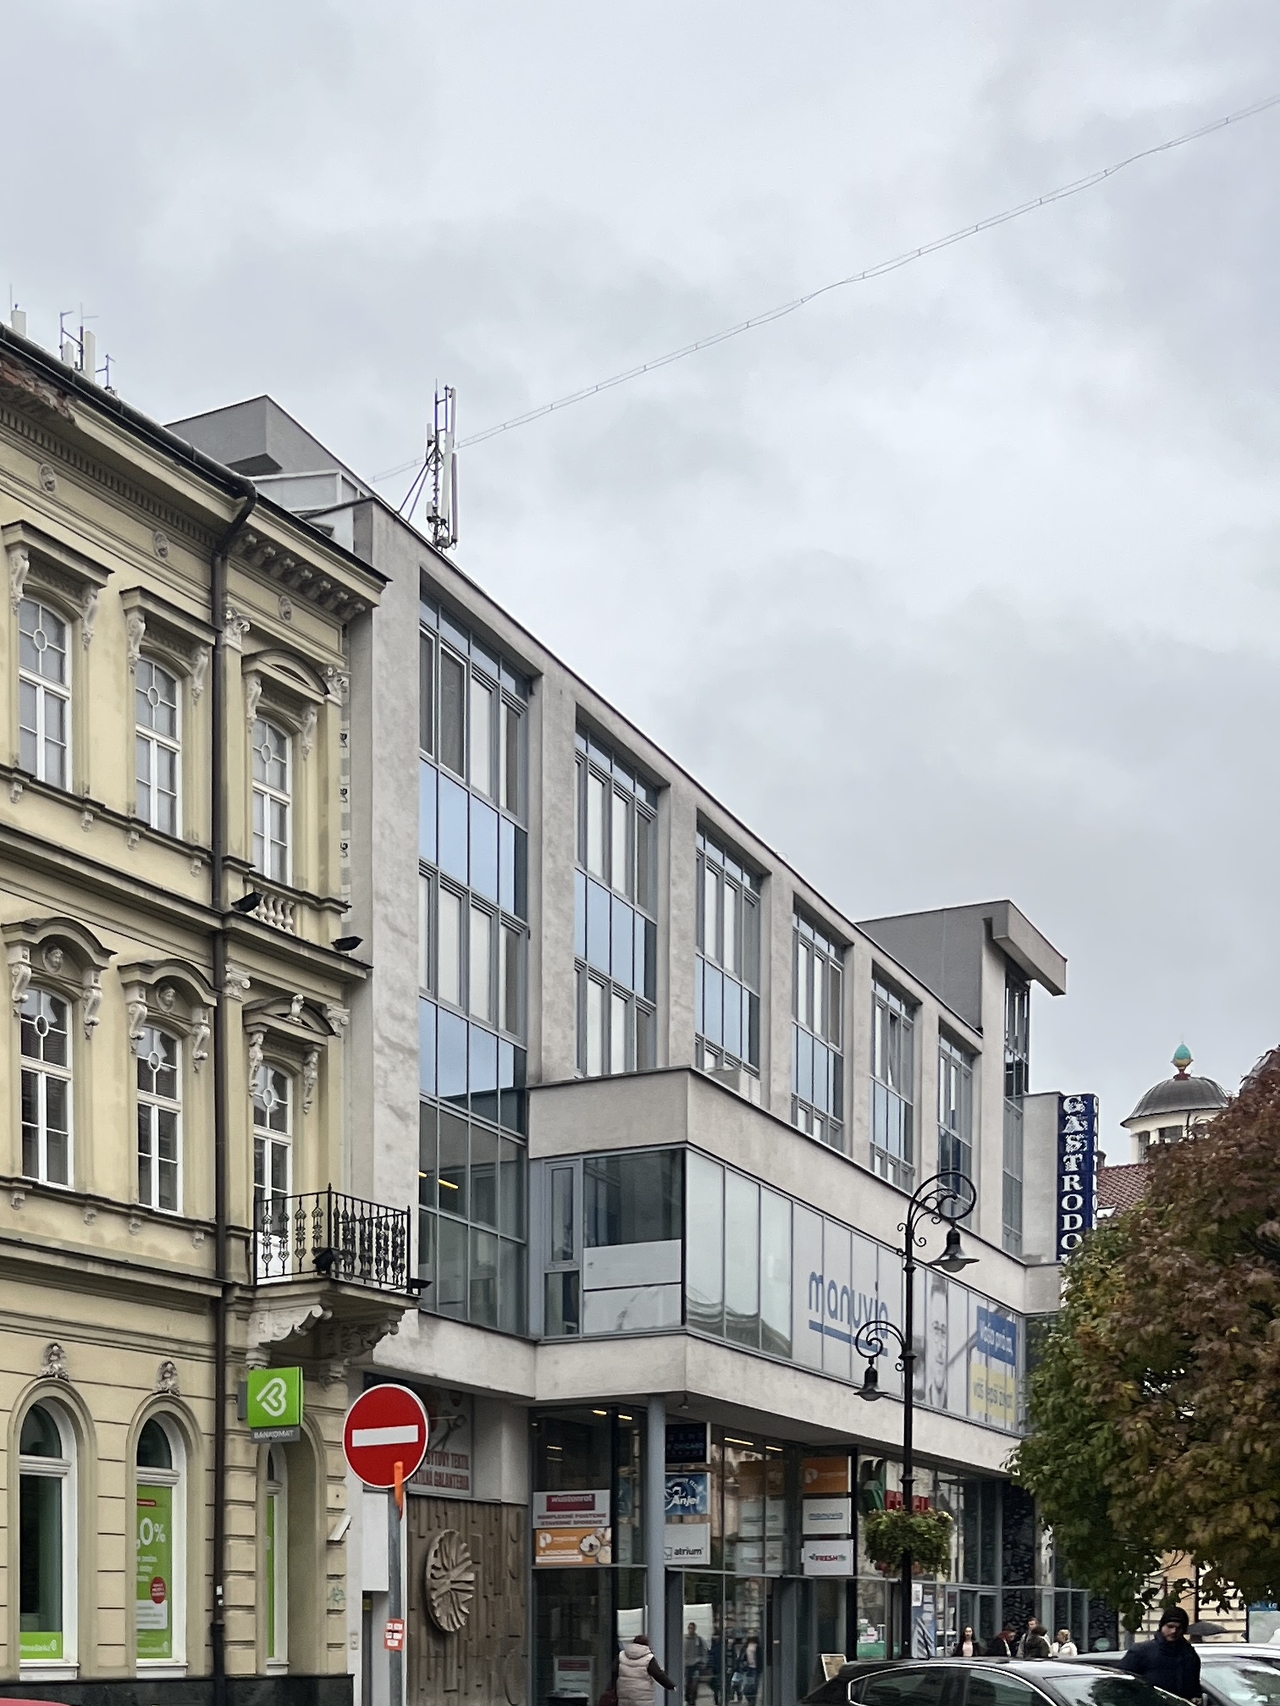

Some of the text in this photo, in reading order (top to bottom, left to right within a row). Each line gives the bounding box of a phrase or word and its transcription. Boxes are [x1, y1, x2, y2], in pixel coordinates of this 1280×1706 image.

[808, 1271, 889, 1340] manuvia
[253, 1429, 294, 1439] BANKOMAT
[674, 1547, 703, 1556] atrium
